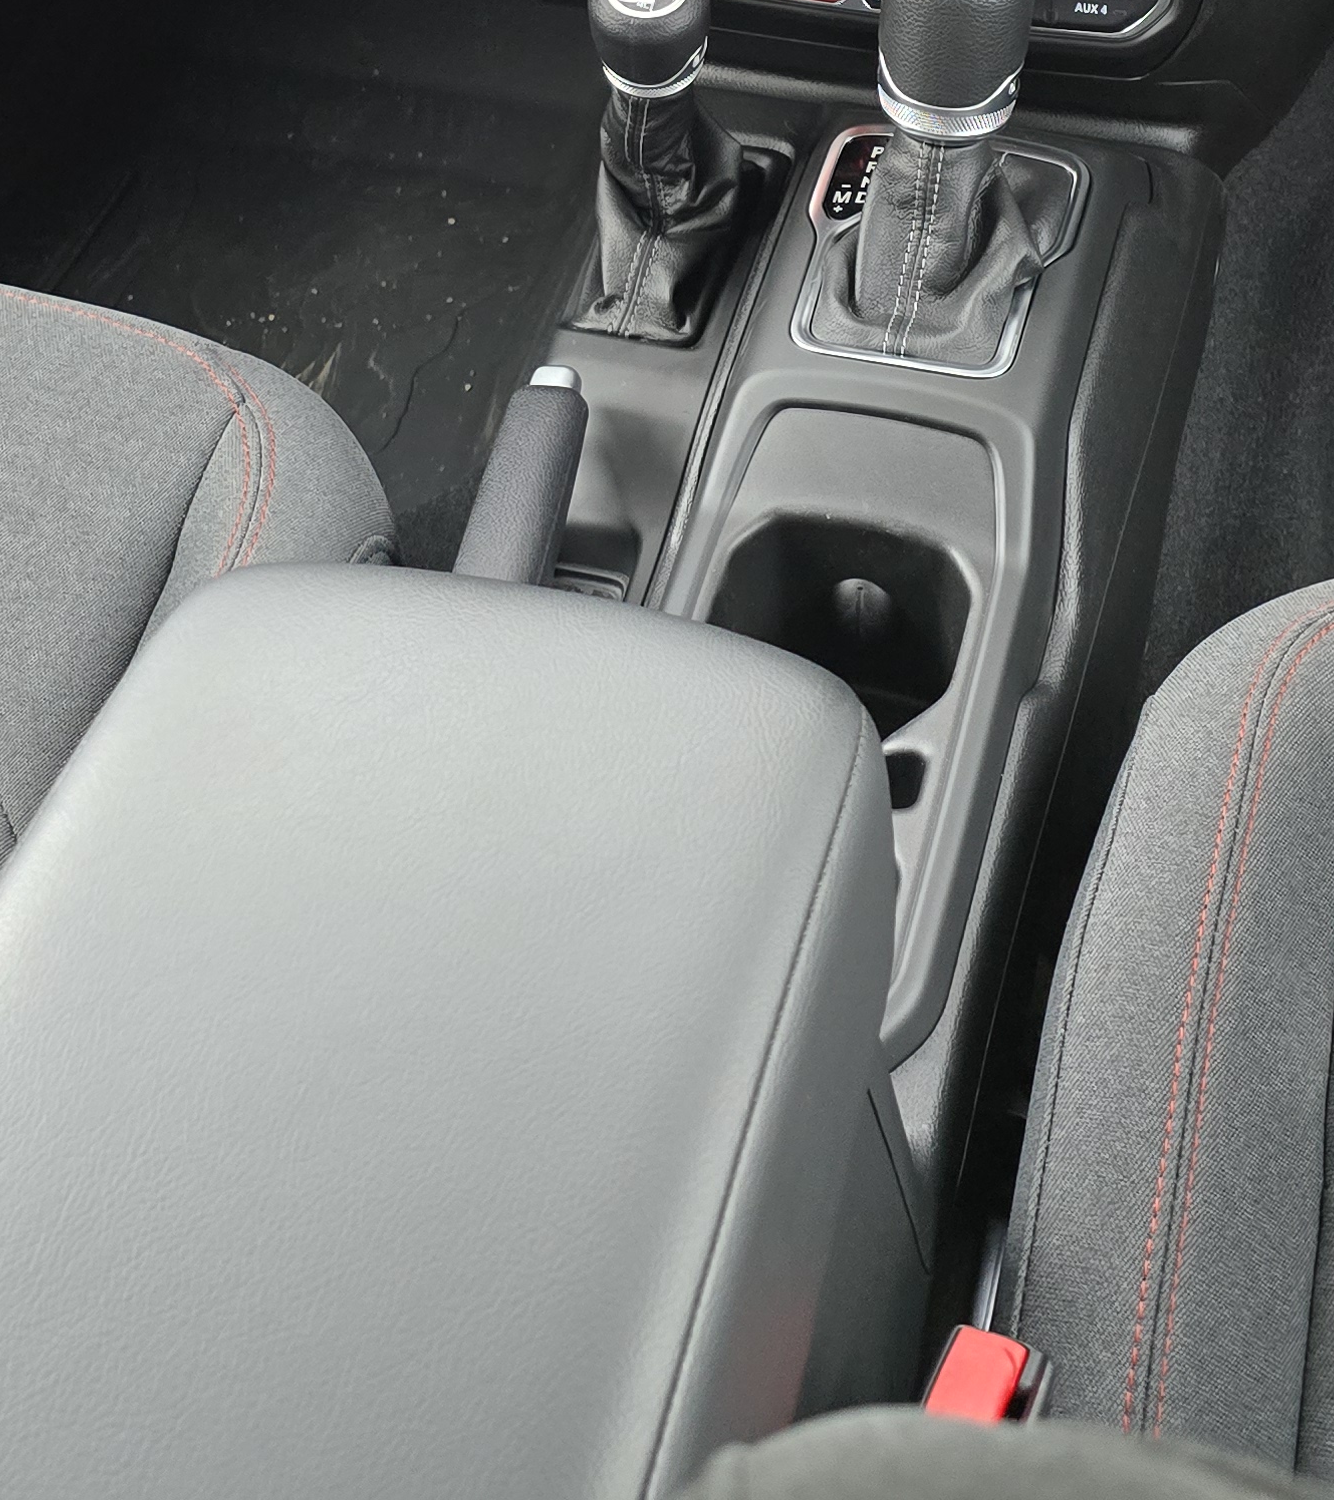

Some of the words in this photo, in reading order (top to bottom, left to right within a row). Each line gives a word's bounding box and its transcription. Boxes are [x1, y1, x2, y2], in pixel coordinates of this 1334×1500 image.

[1074, 2, 1098, 14] AUX
[1100, 4, 1108, 15] 4
[871, 146, 885, 158] P
[833, 191, 852, 204] M
